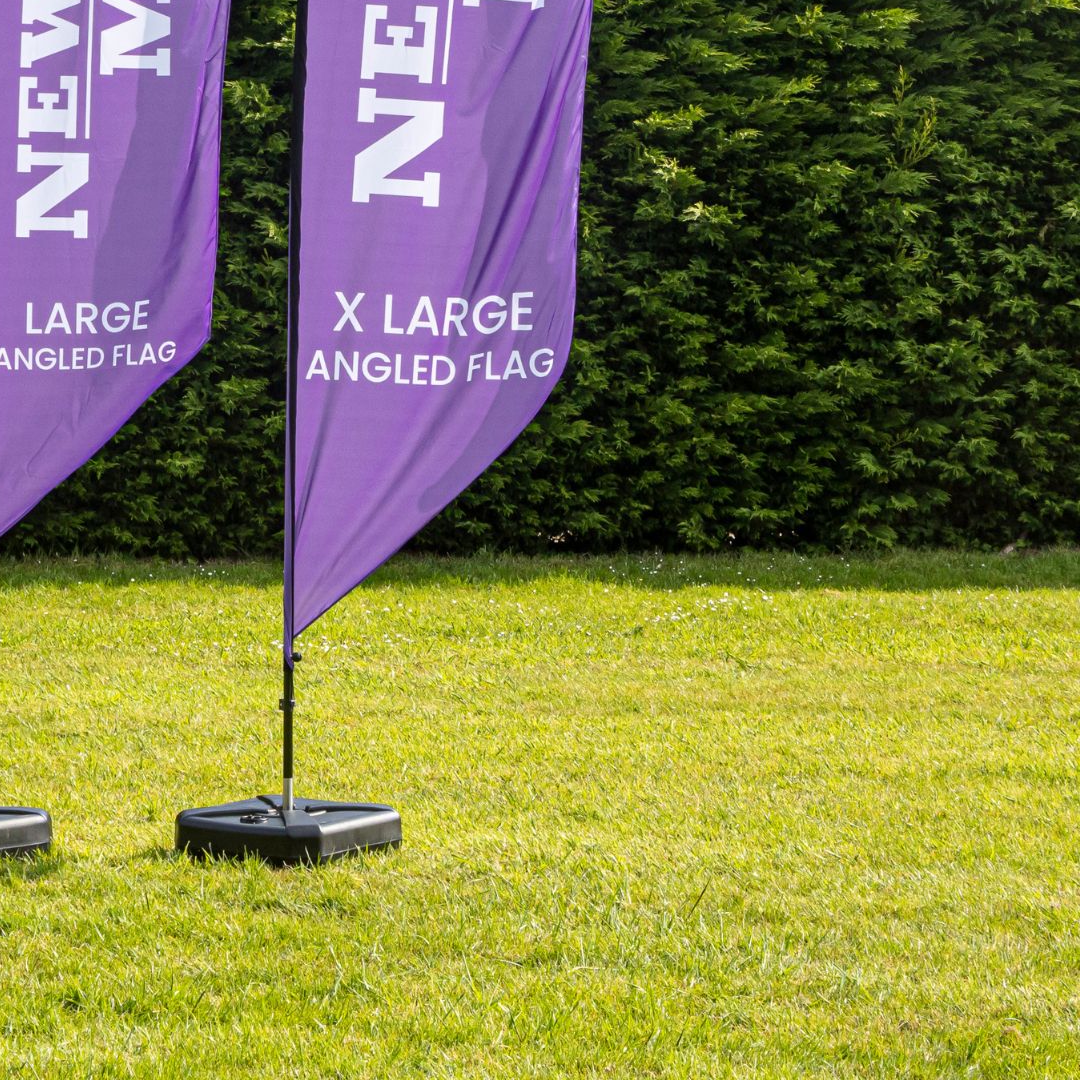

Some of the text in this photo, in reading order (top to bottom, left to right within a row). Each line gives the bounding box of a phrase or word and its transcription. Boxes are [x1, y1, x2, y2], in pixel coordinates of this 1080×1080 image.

[26, 299, 149, 335] LARGE
[333, 291, 534, 338] X LARGE
[111, 340, 176, 366] FLAG
[306, 347, 555, 387] ANGLED FLAG
